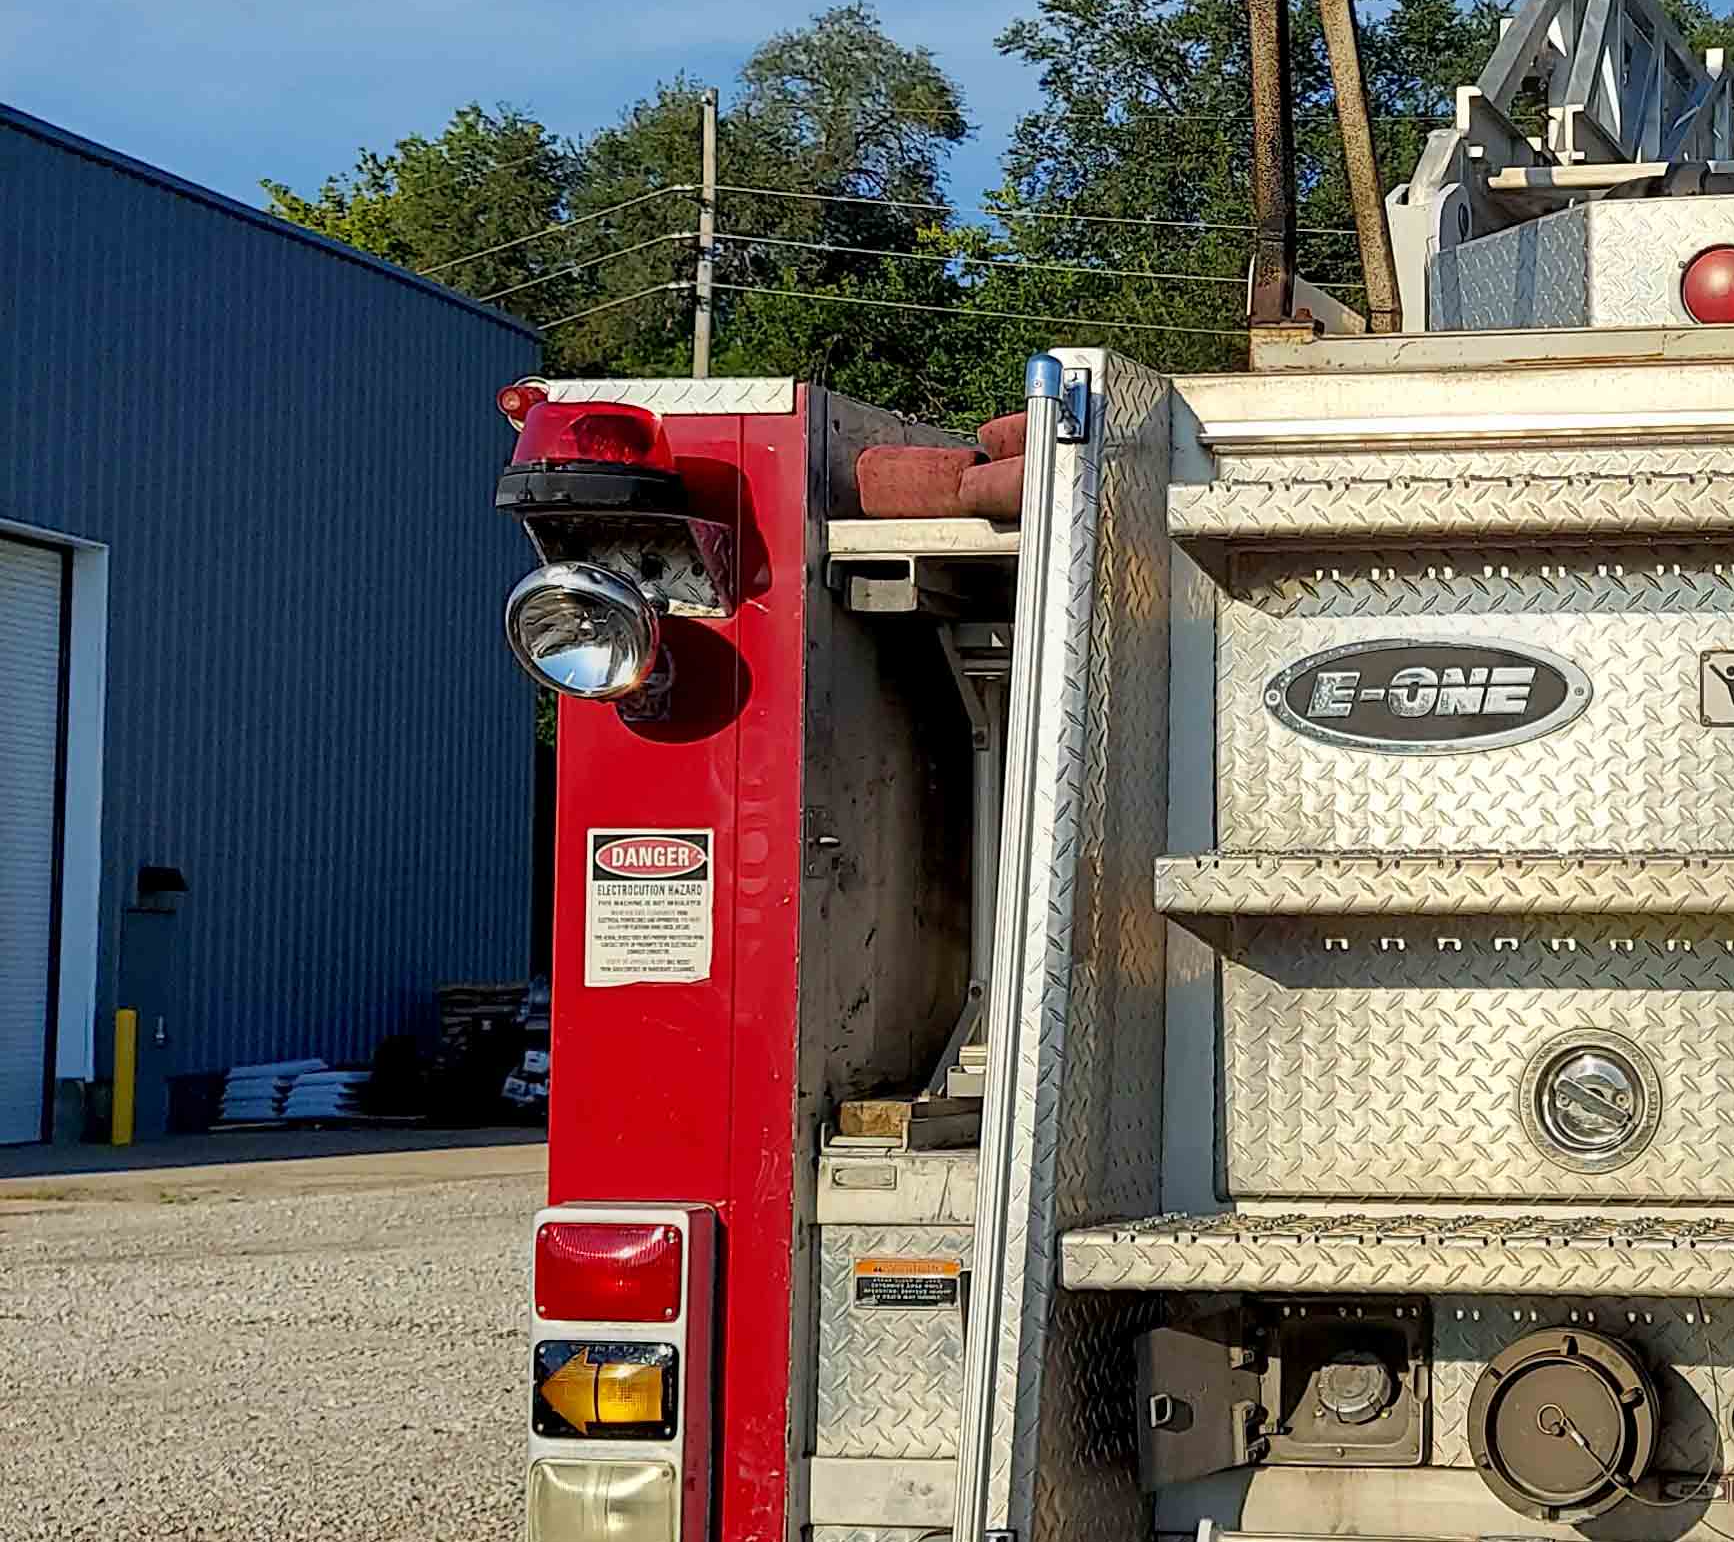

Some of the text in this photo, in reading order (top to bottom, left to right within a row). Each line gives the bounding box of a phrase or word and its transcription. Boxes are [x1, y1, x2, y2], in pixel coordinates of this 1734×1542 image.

[1306, 666, 1537, 718] E-ONE
[611, 847, 690, 867] DANGER
[597, 884, 703, 895] ELECTROCUTION HAZARD
